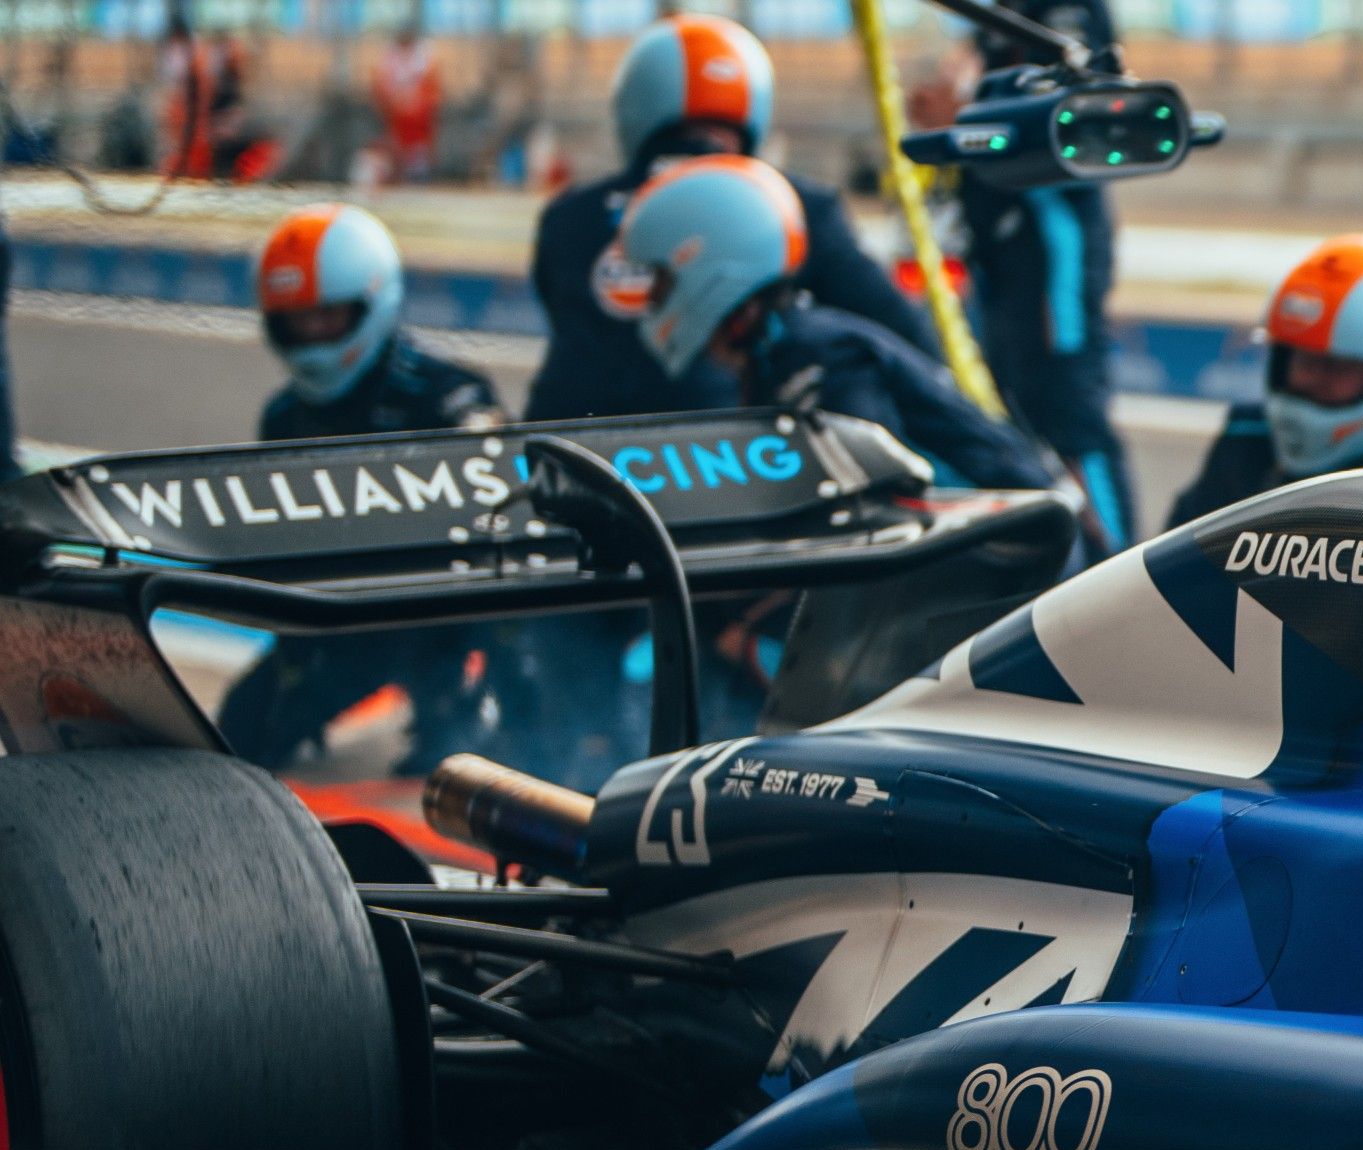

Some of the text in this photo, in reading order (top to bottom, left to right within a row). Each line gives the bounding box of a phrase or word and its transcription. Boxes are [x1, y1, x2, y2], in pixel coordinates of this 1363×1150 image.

[111, 456, 509, 528] WILLIAMS
[761, 768, 846, 800] EST. 1977
